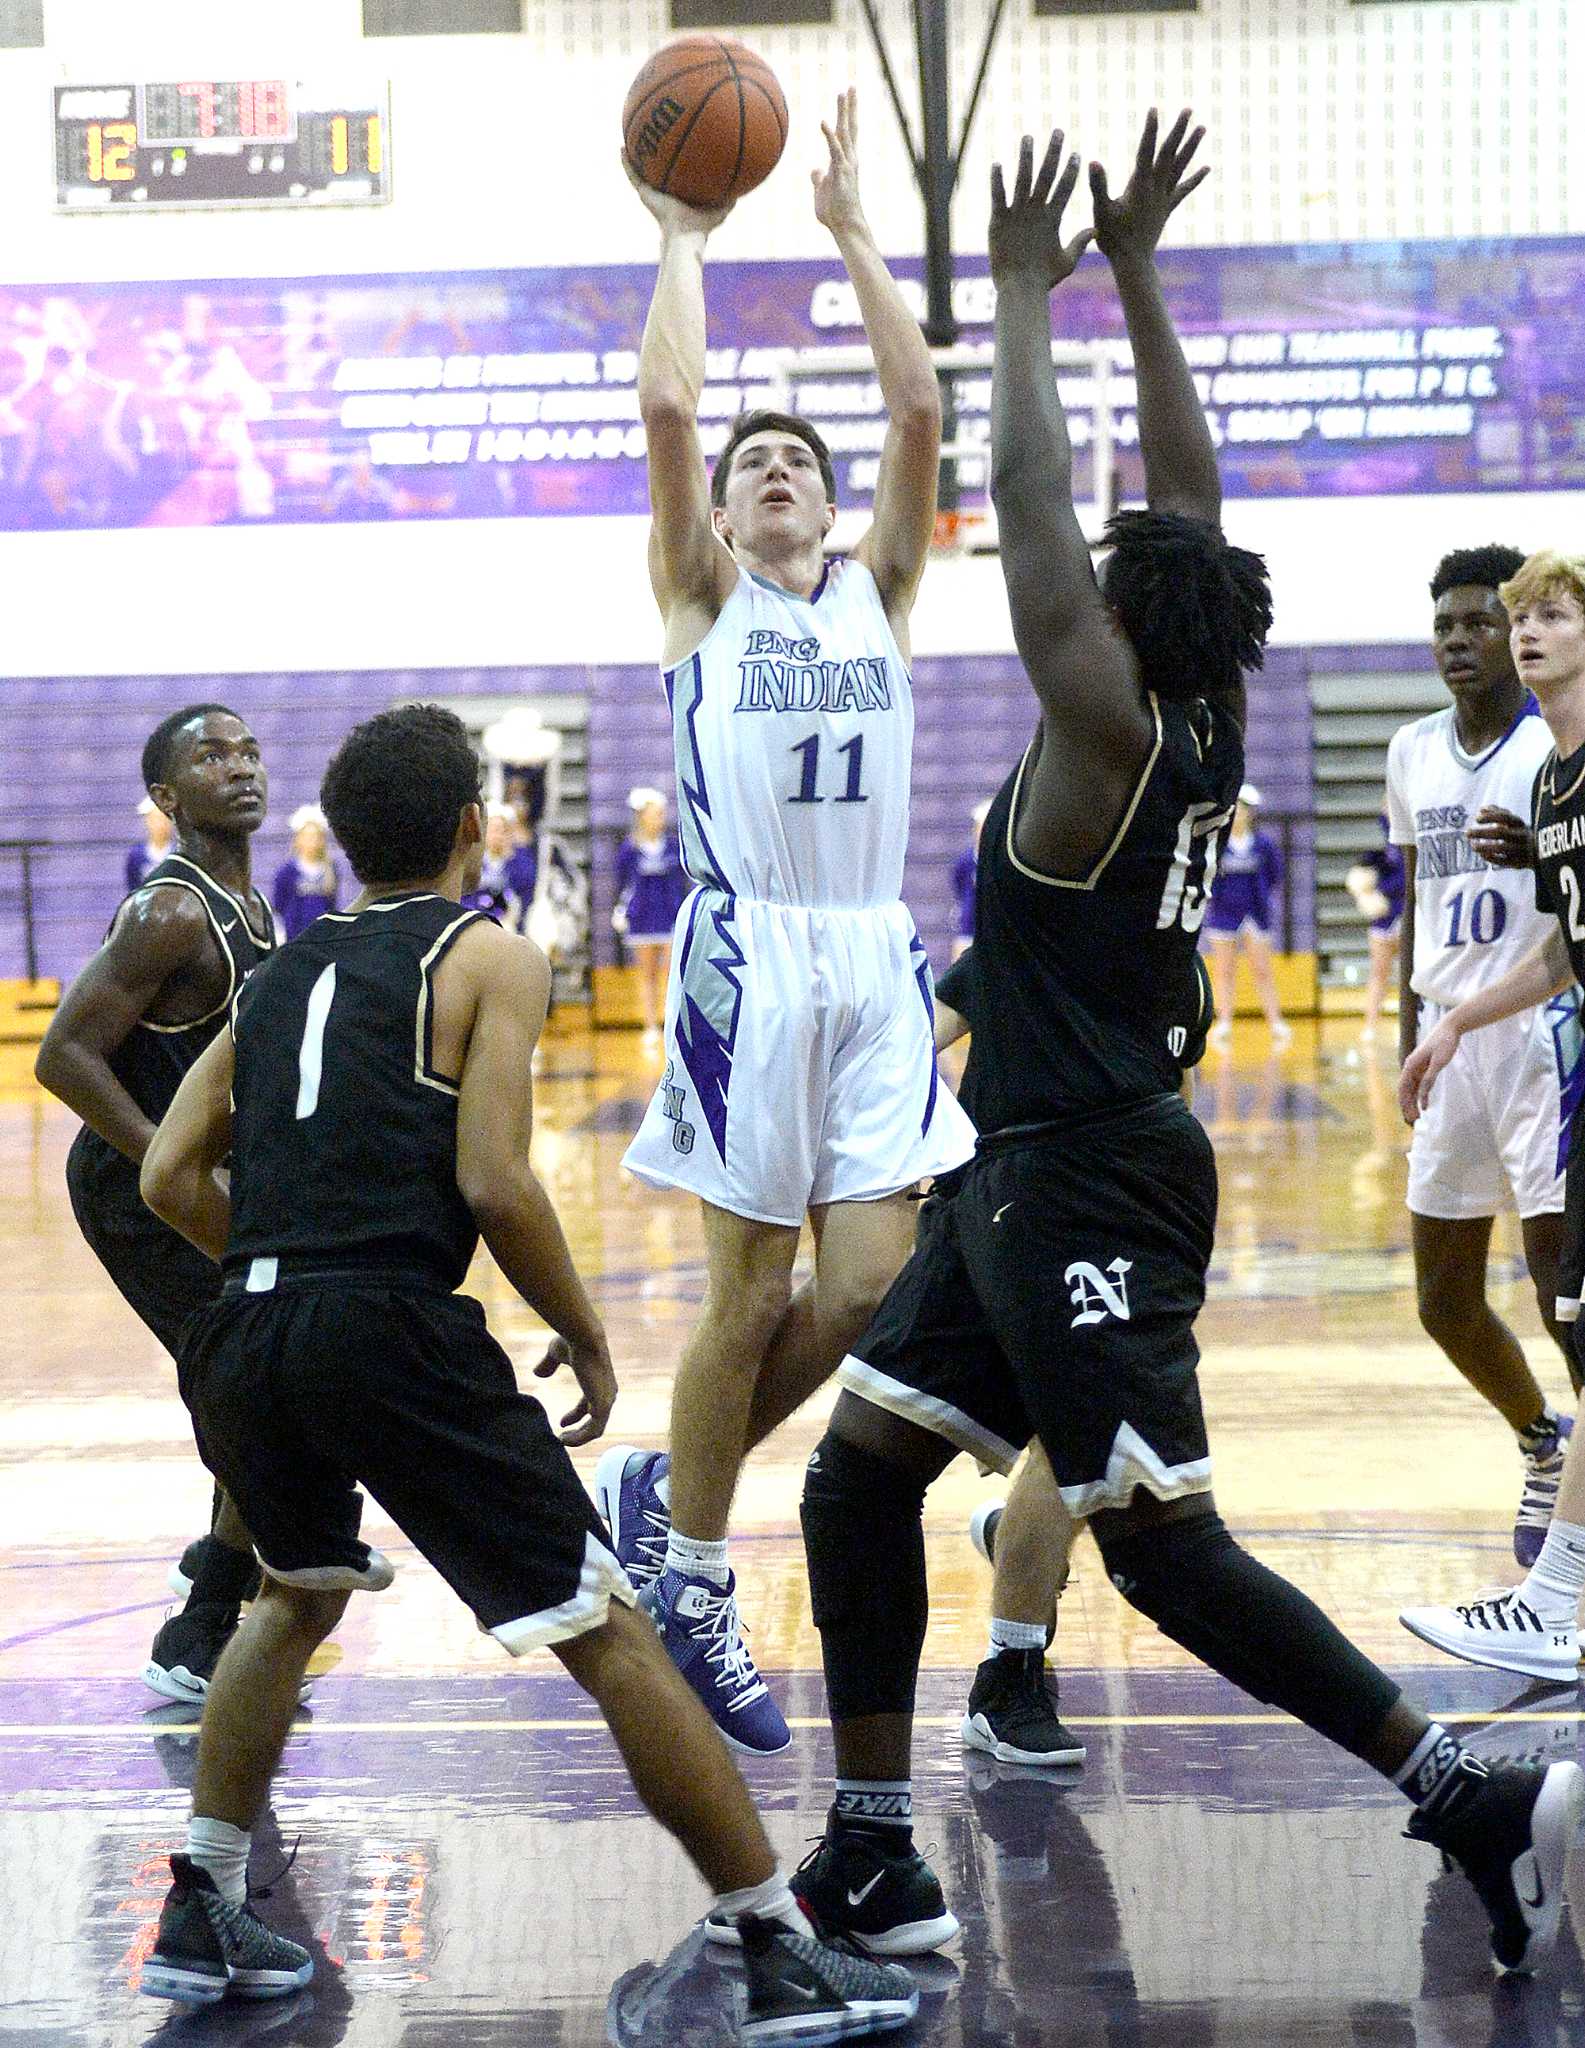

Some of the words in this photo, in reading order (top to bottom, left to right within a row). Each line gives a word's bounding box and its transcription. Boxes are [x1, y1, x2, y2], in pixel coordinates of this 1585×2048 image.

[87, 121, 137, 182] 12
[330, 113, 383, 175] 11
[744, 629, 821, 662] PNG
[733, 656, 893, 714] INDIAN
[786, 732, 869, 803] 11
[1444, 888, 1507, 949] 10
[296, 961, 337, 1121] 1
[1064, 1256, 1134, 1329] N
